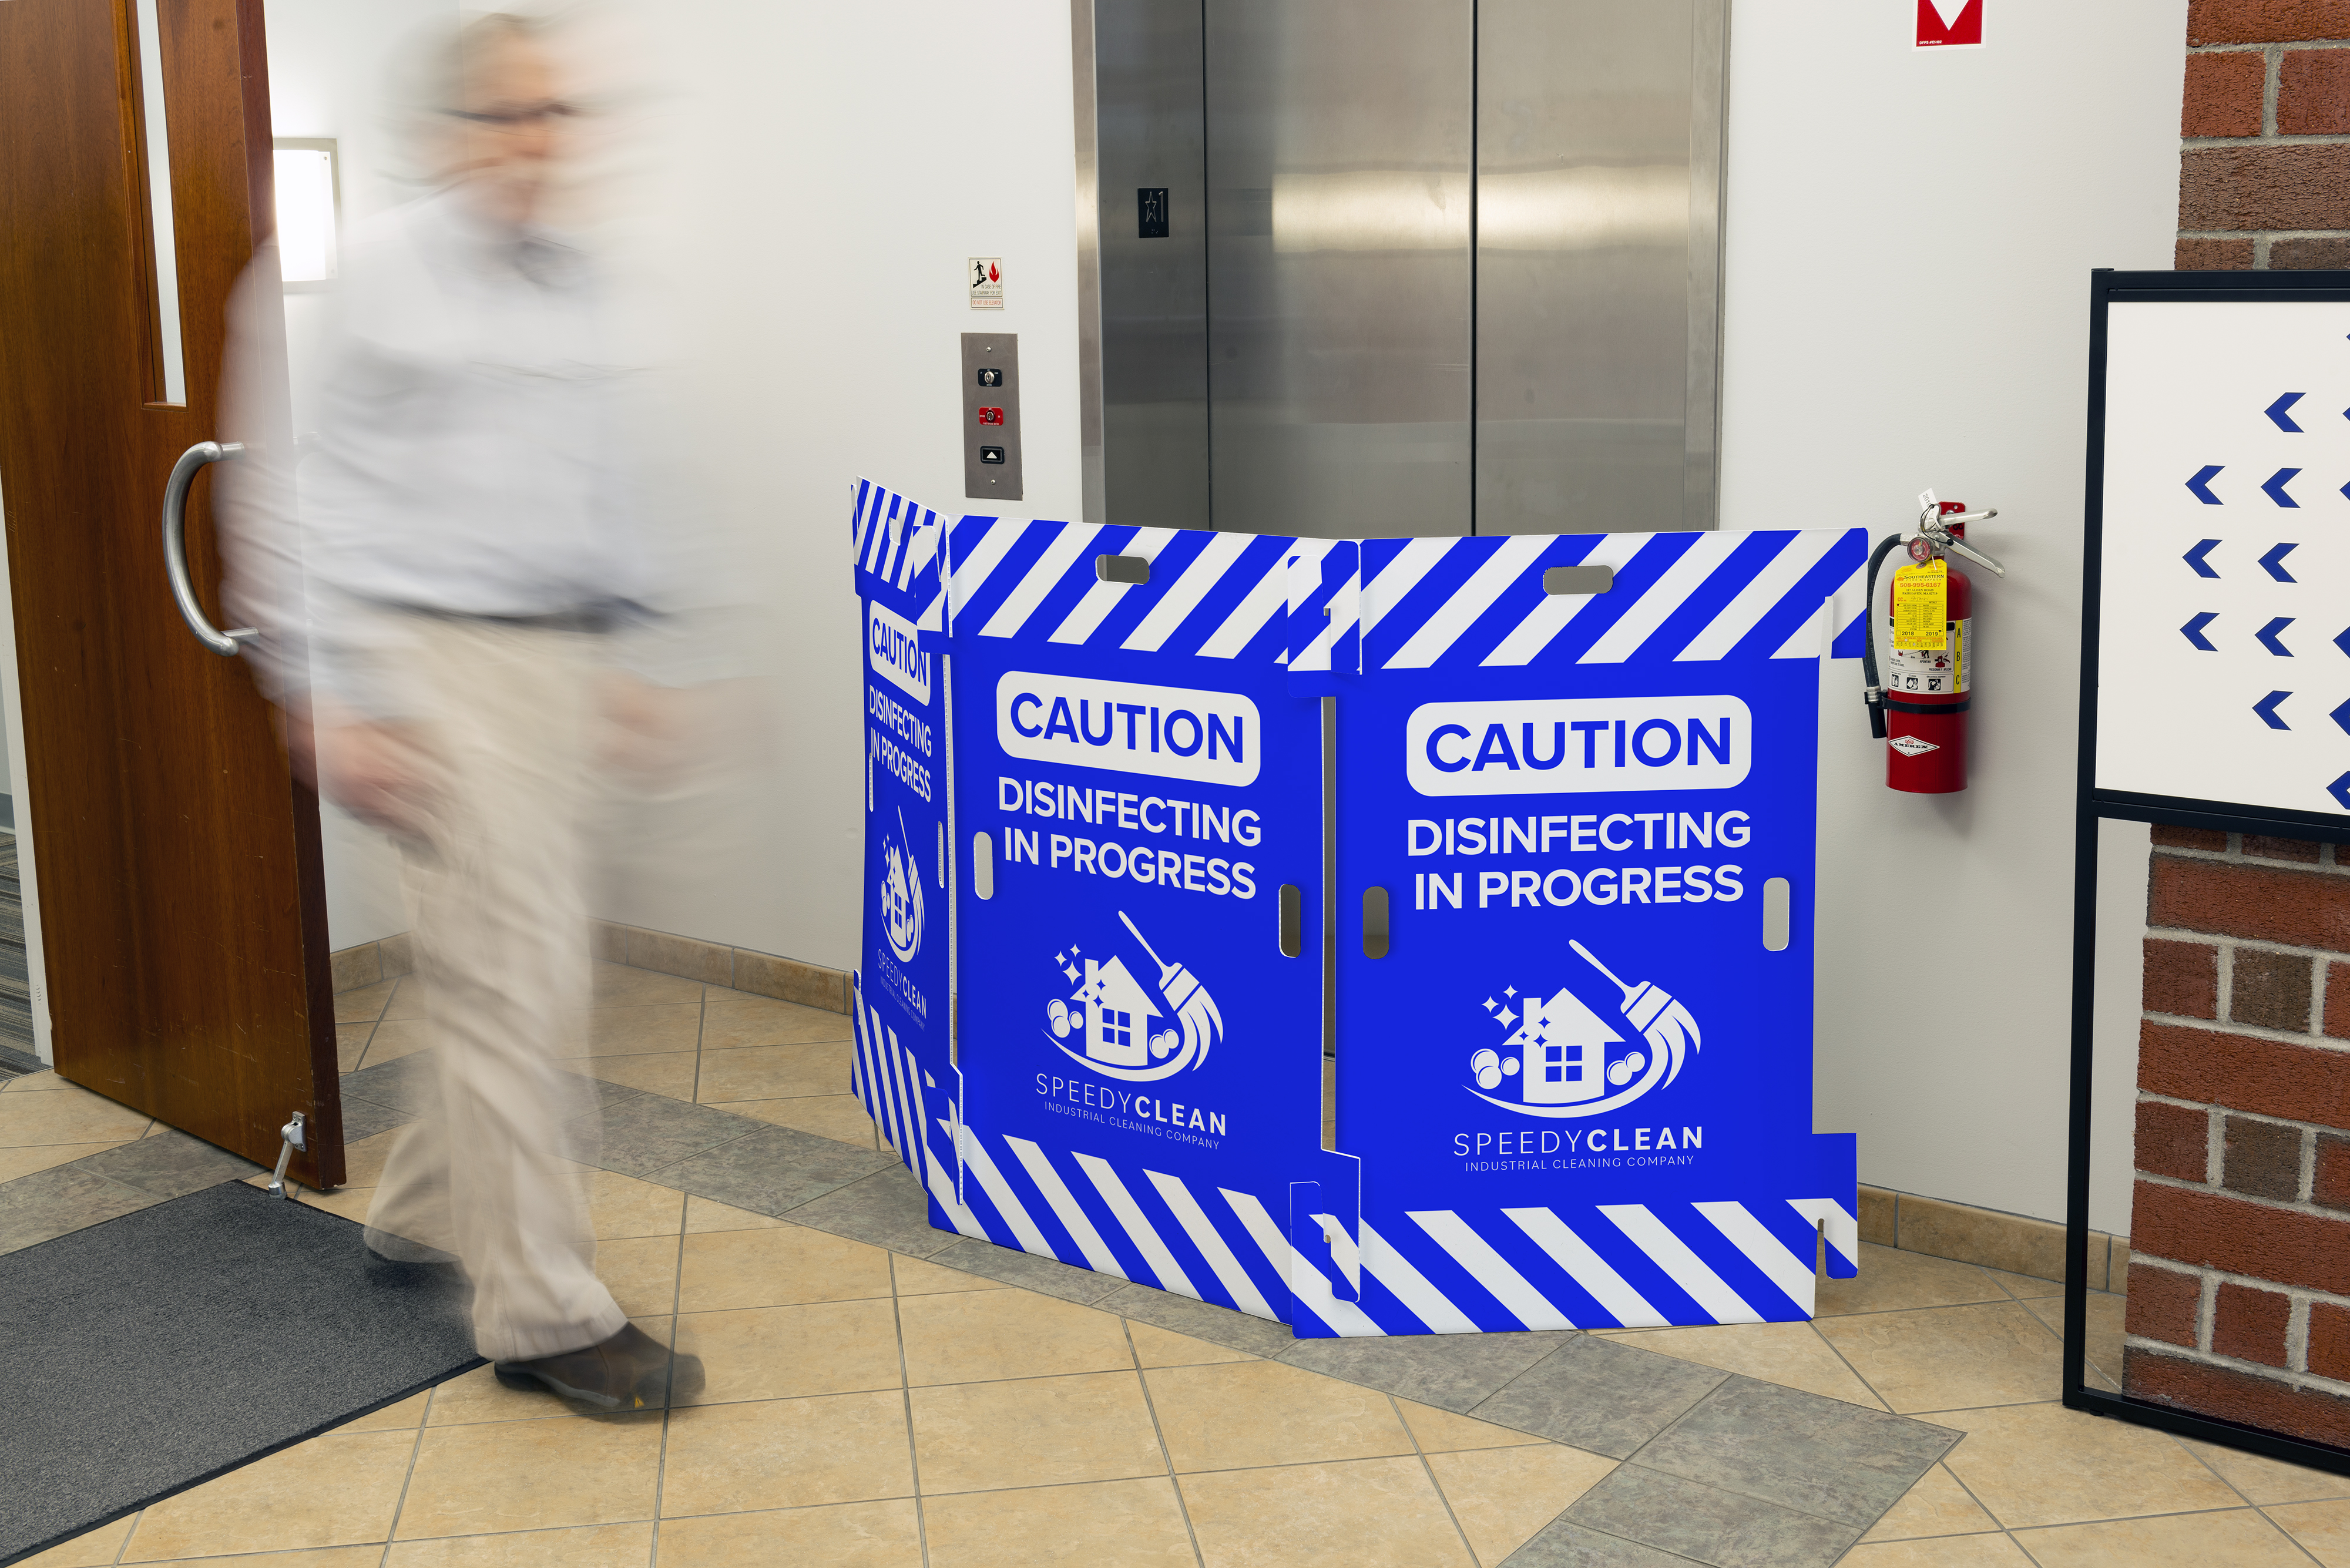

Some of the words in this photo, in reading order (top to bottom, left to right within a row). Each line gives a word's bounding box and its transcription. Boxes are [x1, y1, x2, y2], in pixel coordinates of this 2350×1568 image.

[1159, 191, 1163, 222] 1
[1922, 493, 1932, 507] 2019
[872, 617, 926, 687] CAUTION
[1956, 652, 1960, 662] B
[1957, 628, 1961, 638] A
[1956, 674, 1960, 685] C
[870, 684, 932, 757] DISINFECTING
[1010, 692, 1243, 763] CAUTION
[871, 727, 880, 762] IN
[882, 735, 931, 803] PROGRESS
[1426, 717, 1731, 773] CAUTION
[999, 776, 1261, 847] DISINFECTING
[1408, 810, 1751, 857] DISINFECTING
[1005, 827, 1039, 865] IN
[1050, 834, 1256, 899] PROGRESS
[1415, 872, 1462, 910] IN
[1479, 864, 1744, 908] PROGRESS
[878, 949, 926, 1019] SPEEDYCLEAN
[1036, 1073, 1226, 1136] SPEEDYCLEAN
[1045, 1102, 1106, 1124] INDUSTRIAL
[1109, 1117, 1162, 1137] CLEANING
[1166, 1130, 1220, 1150] COMPANY
[1453, 1126, 1702, 1156] SPEEDYCLEAN
[1465, 1160, 1547, 1171] INDUSTRIAL
[1553, 1157, 1621, 1169] CLEANING
[1627, 1155, 1694, 1166] COMPANY
